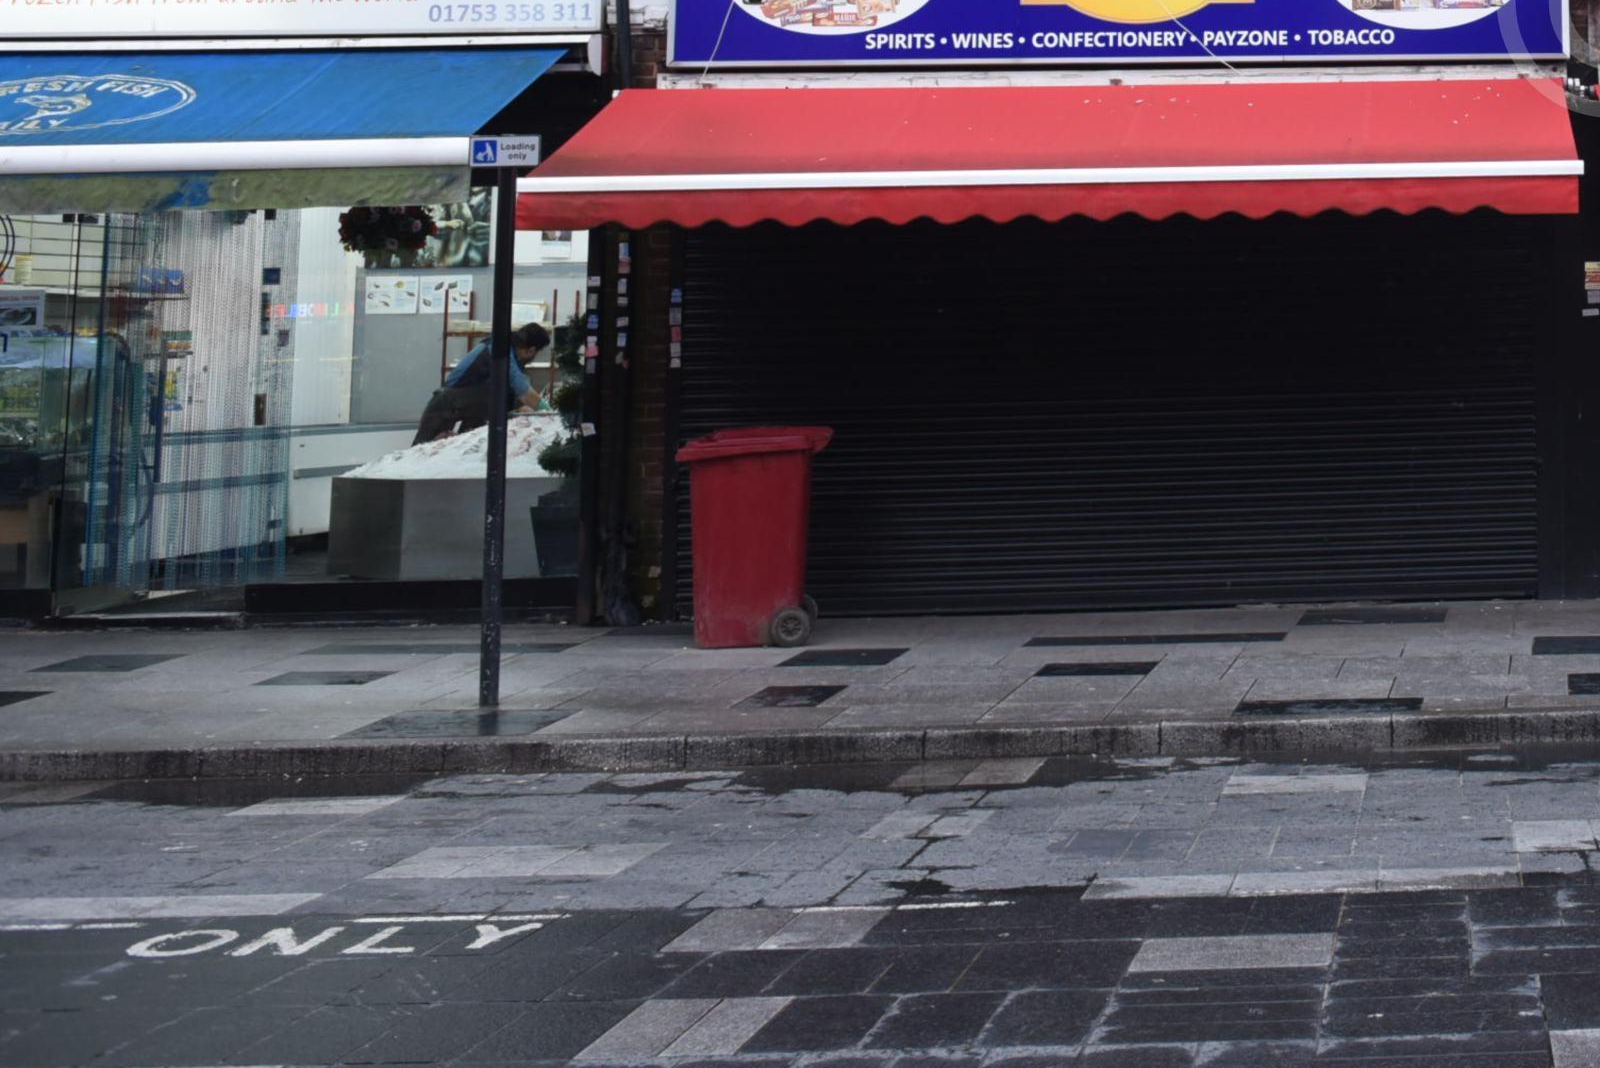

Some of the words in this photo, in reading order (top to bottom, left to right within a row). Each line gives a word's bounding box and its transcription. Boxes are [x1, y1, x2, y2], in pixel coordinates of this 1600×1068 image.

[428, 5, 497, 22] 01753
[505, 4, 545, 22] 358
[553, 3, 592, 21] 311
[865, 33, 936, 50] SPIRITS
[953, 33, 1013, 49] WINES
[1032, 30, 1186, 48] CONFECTIONERY
[1203, 30, 1289, 47] PAYZONE
[1308, 29, 1395, 46] TOBACCO
[500, 143, 535, 151] Loading
[126, 922, 544, 957] ONLY
